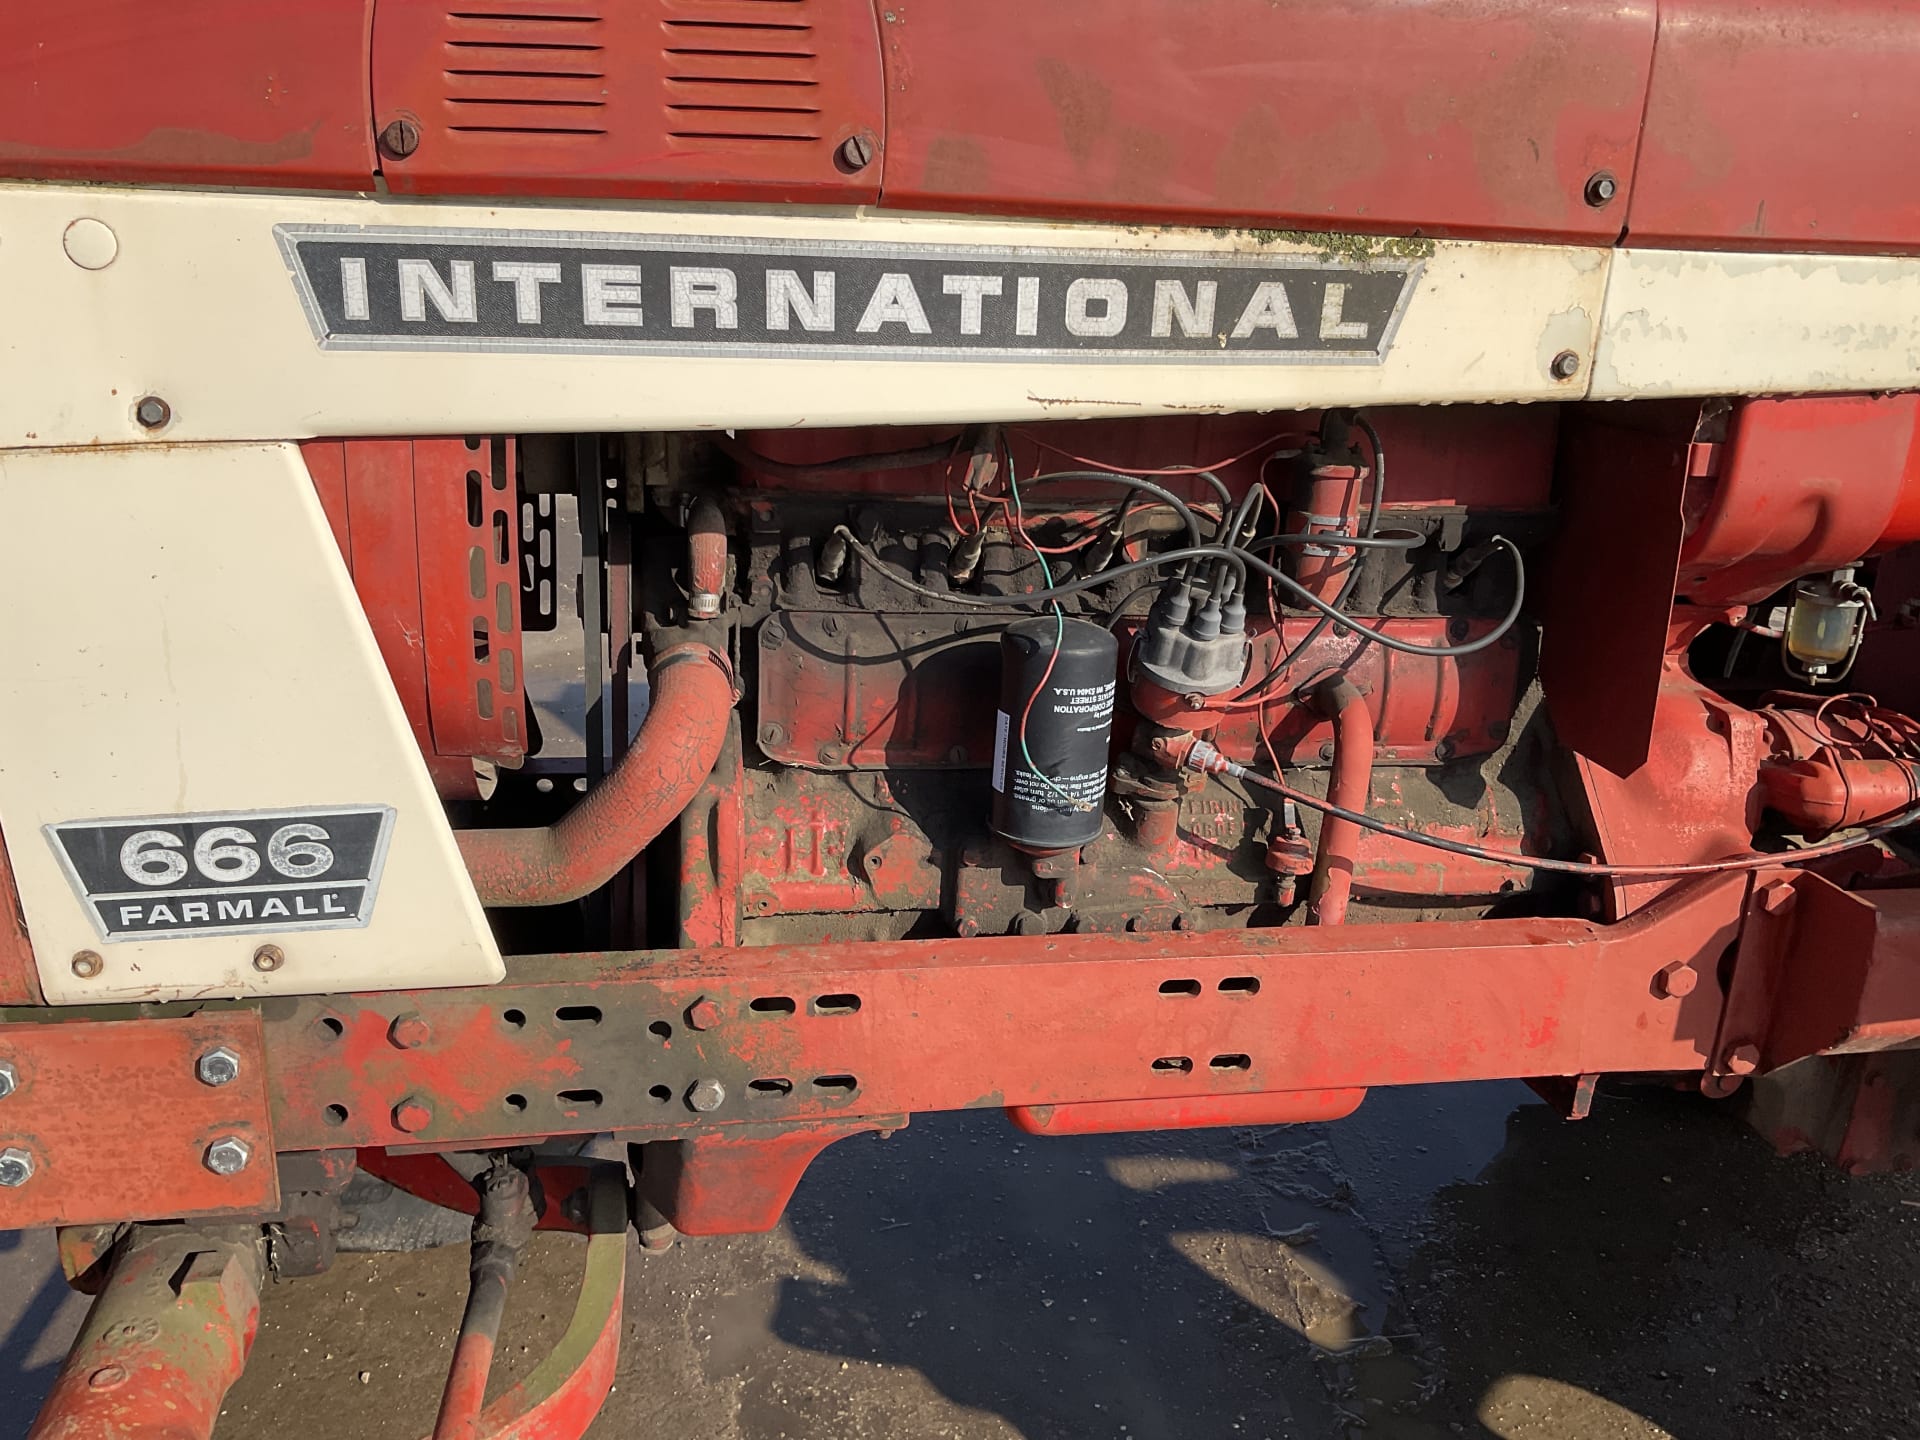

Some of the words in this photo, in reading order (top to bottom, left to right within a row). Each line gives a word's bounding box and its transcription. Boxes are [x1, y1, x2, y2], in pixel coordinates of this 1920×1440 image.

[340, 257, 1368, 341] INTERNATIONAL
[1053, 702, 1105, 713] CORPORATION
[1070, 696, 1097, 704] STREET
[119, 823, 334, 886] 666
[119, 894, 346, 926] FARMALL
